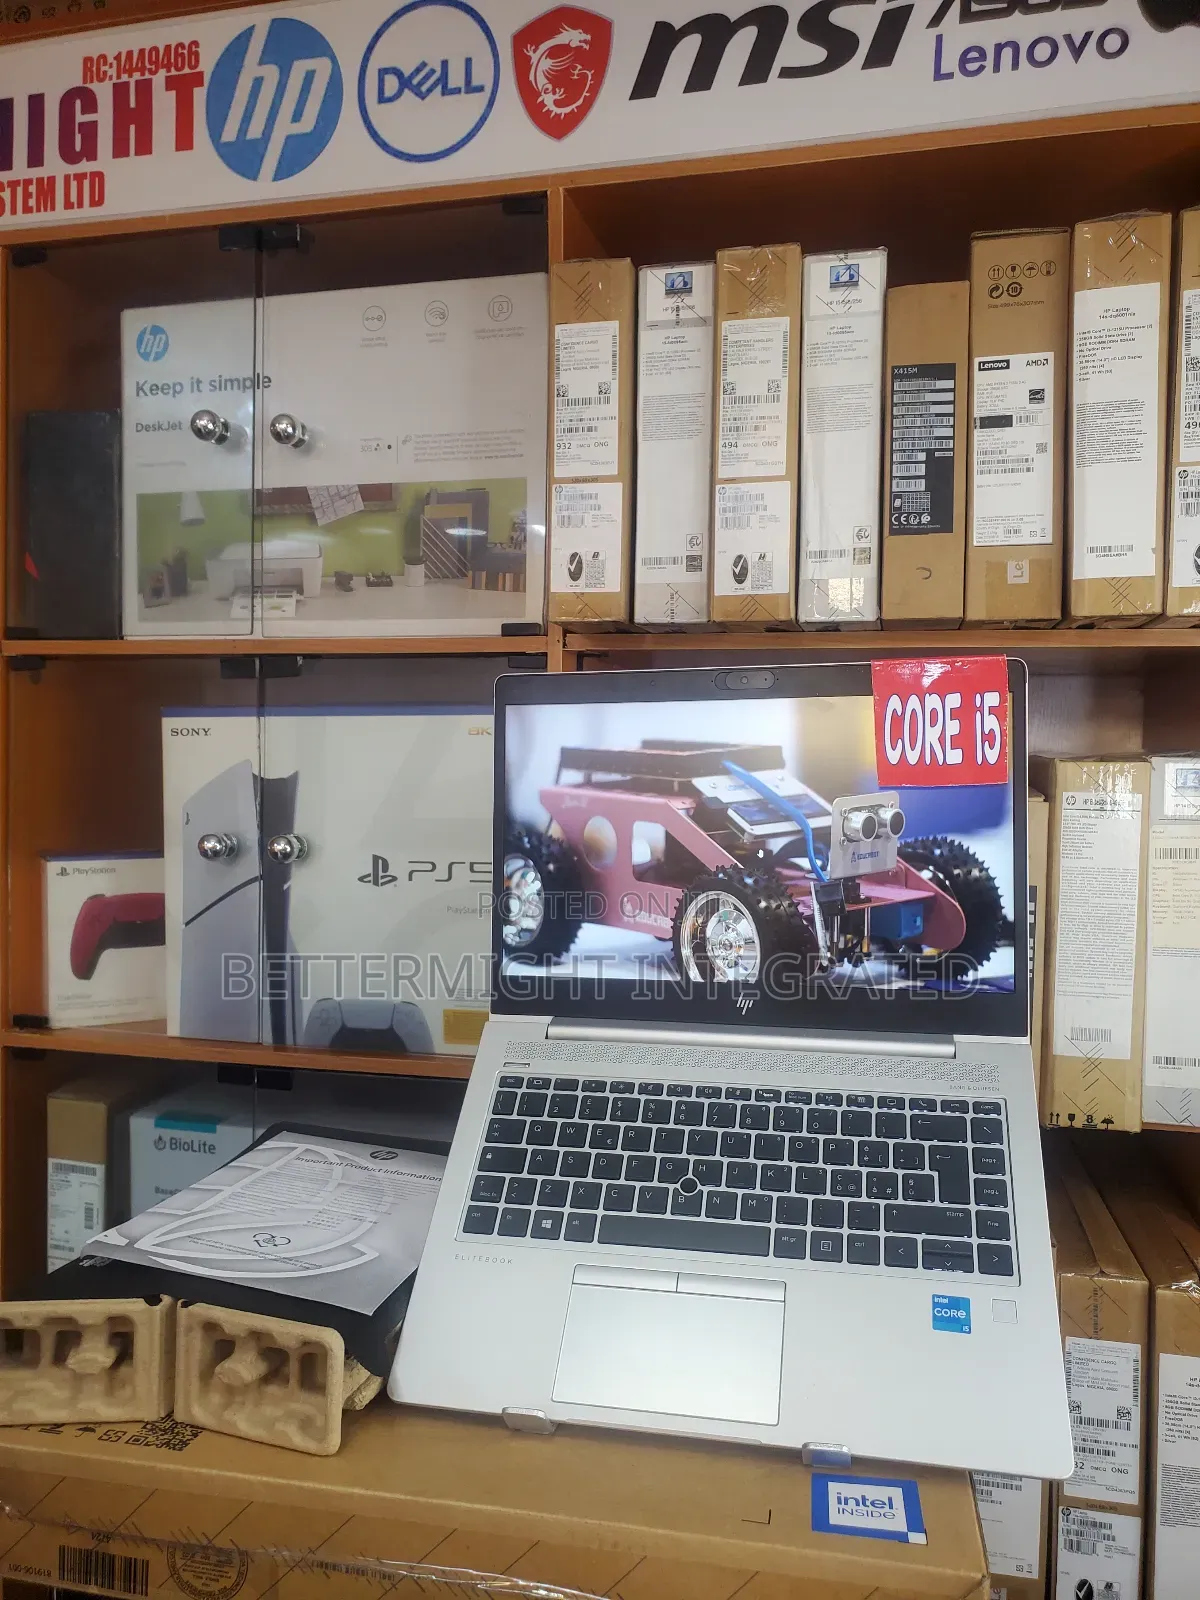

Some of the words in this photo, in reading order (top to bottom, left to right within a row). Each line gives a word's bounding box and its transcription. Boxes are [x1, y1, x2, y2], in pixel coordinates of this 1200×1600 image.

[82, 40, 201, 84] RC:1449466
[932, 26, 1130, 82] Lenovo
[377, 56, 485, 104] DELL
[220, 18, 333, 182] hp
[0, 71, 204, 171] IGHT
[63, 171, 105, 210] LTD
[138, 324, 167, 362] hp
[135, 380, 184, 398] Keep
[190, 377, 203, 393] it
[208, 372, 272, 393] simple
[135, 420, 183, 433] DeskJet
[556, 442, 572, 450] 932
[721, 441, 738, 449] 494
[170, 728, 211, 737] SONY
[884, 692, 963, 766] CORE
[975, 691, 1002, 766] i5
[72, 867, 116, 877] PlayStation
[408, 861, 493, 883] PS5
[169, 1136, 216, 1154] BioLite
[295, 1155, 343, 1167] Important
[344, 1162, 383, 1174] Product
[384, 1168, 442, 1182] Information
[803, 1172, 808, 1180] L
[748, 1199, 756, 1207] M
[455, 1254, 513, 1264] ELITEBOOK
[836, 1492, 894, 1510] intel
